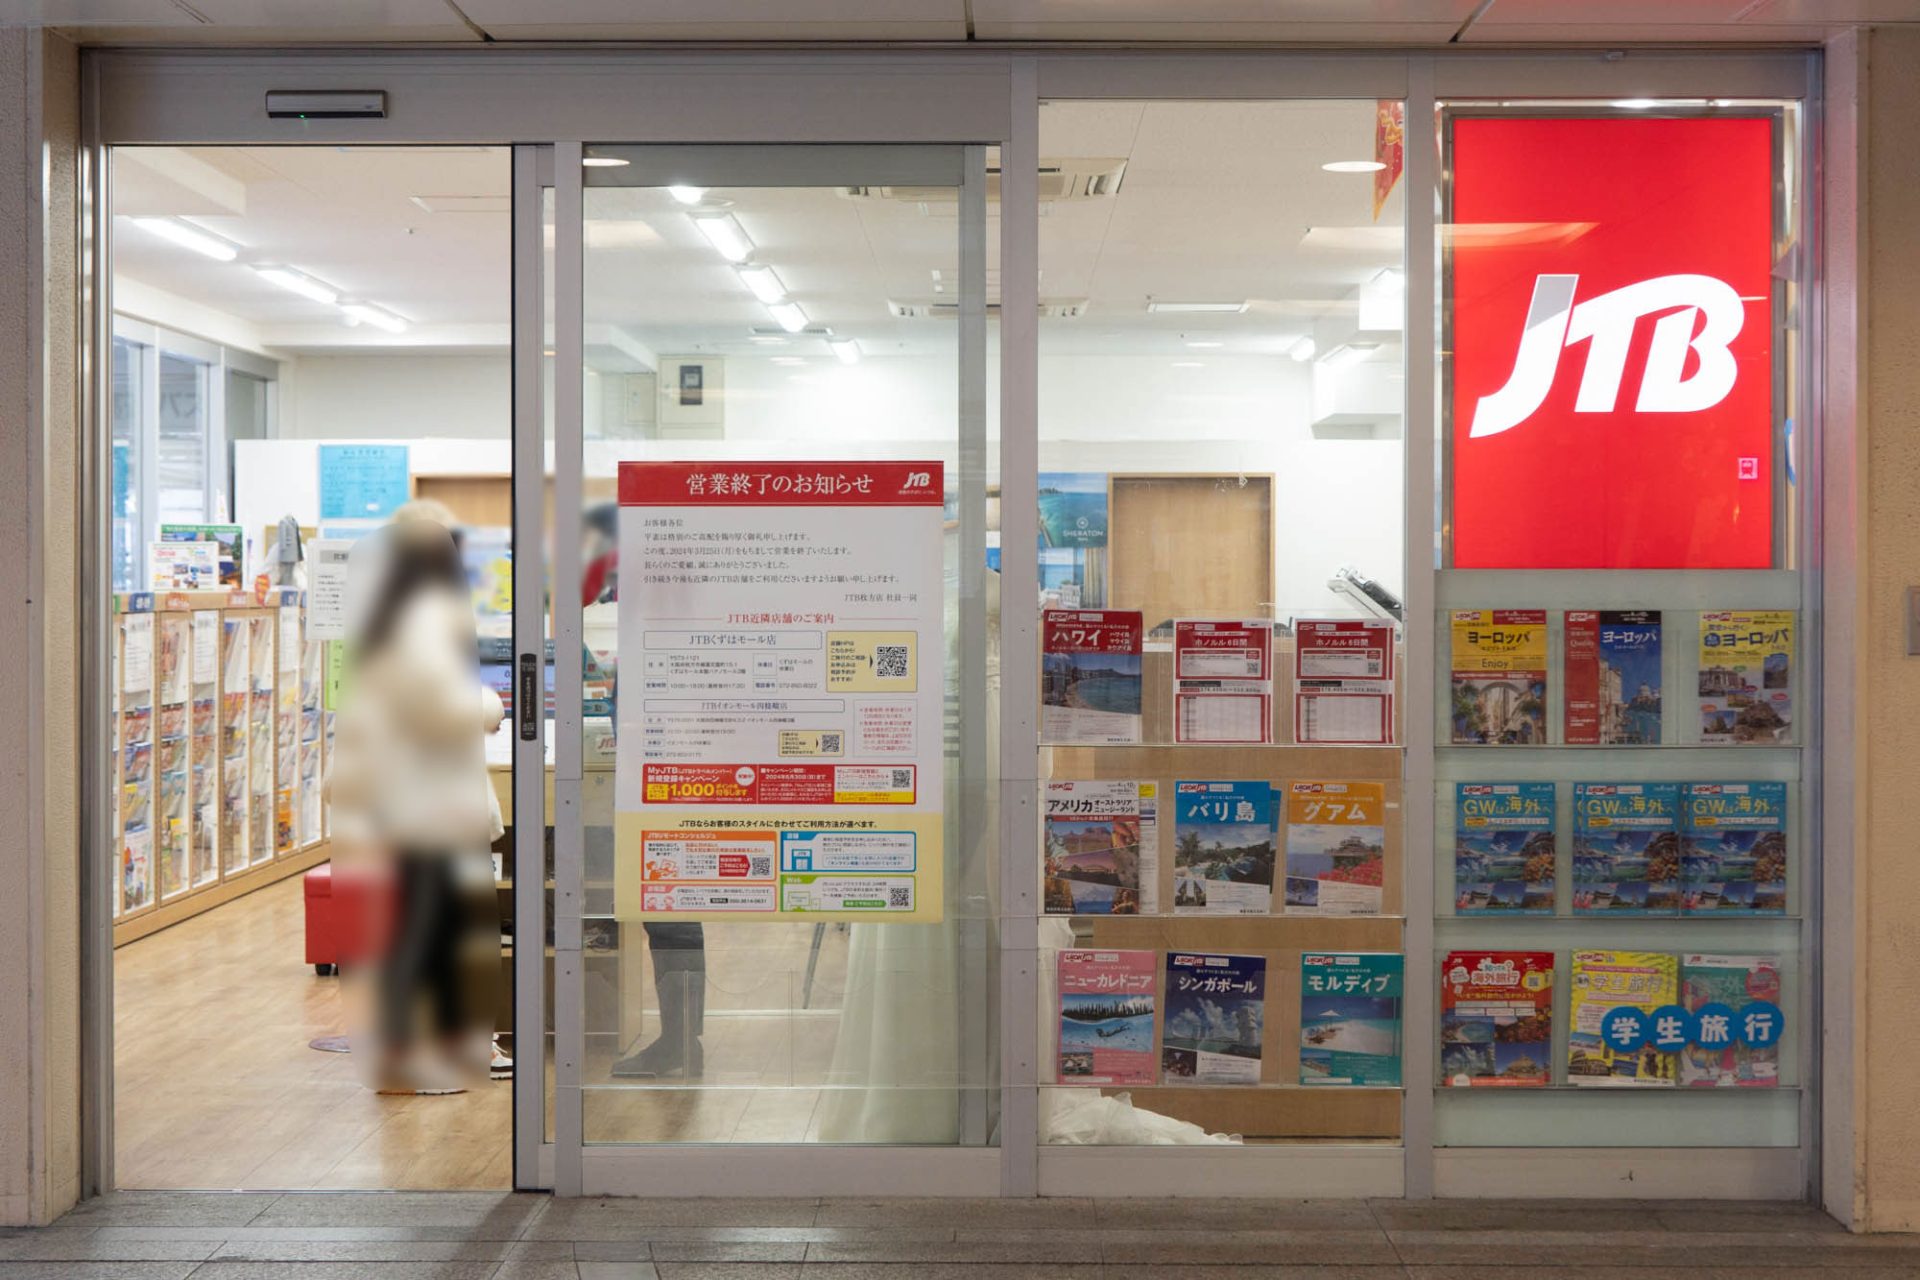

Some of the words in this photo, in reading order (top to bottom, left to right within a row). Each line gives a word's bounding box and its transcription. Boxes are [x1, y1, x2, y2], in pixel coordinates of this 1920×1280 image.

[1470, 274, 1744, 438] JTB
[686, 473, 873, 495] 営業終了のお知らせ
[903, 472, 930, 489] JTB
[727, 613, 835, 624] JTB近隣店舗のご案内
[689, 634, 777, 646] JTBくずはモール店
[1052, 630, 1101, 646] ハワイ
[1468, 631, 1531, 644] ヨーロッパ
[1602, 630, 1657, 644] ヨーロッパ
[1722, 628, 1789, 647] ヨーロッパ
[1482, 658, 1509, 669] Enjoy
[671, 783, 715, 797] 1,000
[1048, 800, 1093, 813] アメリカ
[1187, 801, 1256, 822] バリ島
[1304, 801, 1366, 821] グアム
[1463, 794, 1551, 815] GWは海外へ
[679, 820, 878, 829] JTBならお客様のスタイルに合わせてご利用方法が選べます。
[1064, 973, 1153, 988] ニューカレドニア
[1179, 976, 1257, 993] シンガポール
[1308, 974, 1391, 993] モルディブ
[1472, 972, 1520, 985] 海外旅行
[1611, 1013, 1773, 1046] 学生旅行
